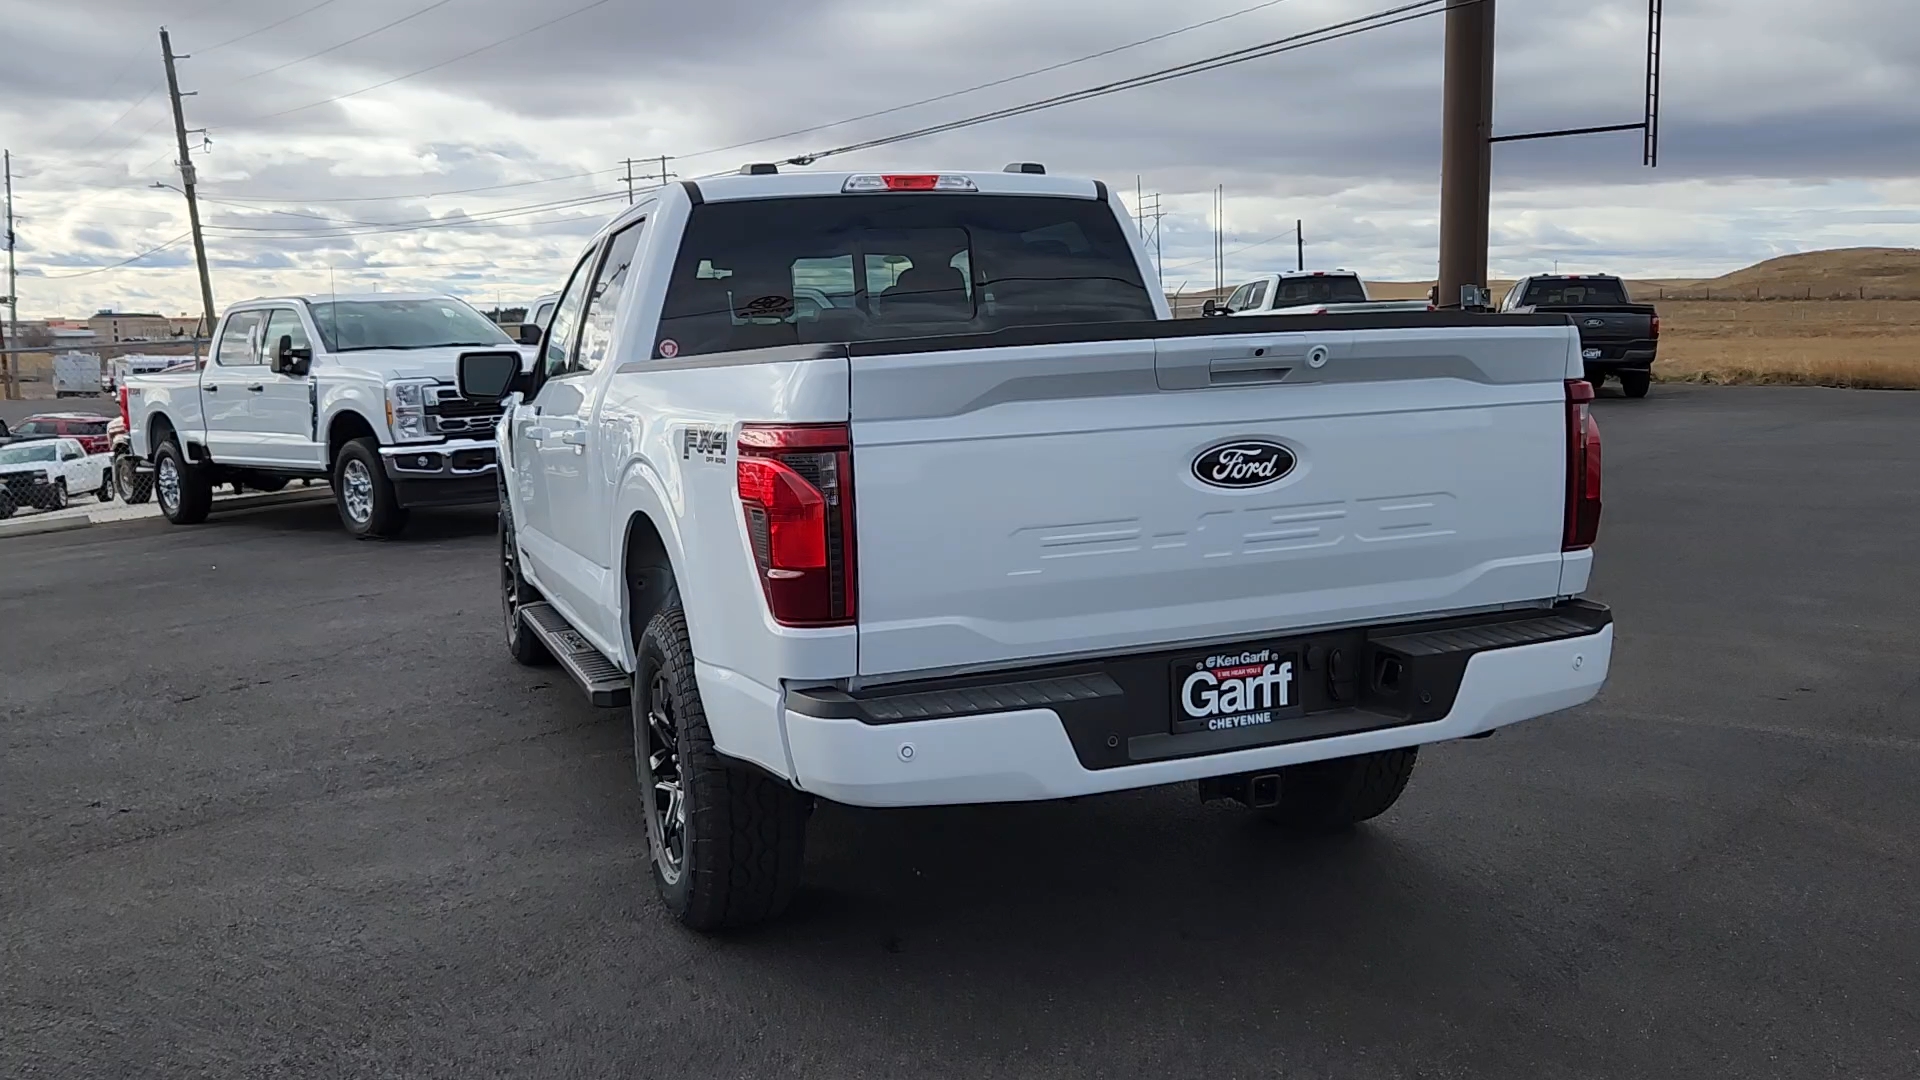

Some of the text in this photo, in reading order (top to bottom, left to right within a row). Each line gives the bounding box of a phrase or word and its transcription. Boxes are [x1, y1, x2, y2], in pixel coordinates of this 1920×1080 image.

[683, 428, 728, 460] FX4
[1212, 448, 1279, 480] Ford
[1216, 649, 1270, 667] Ken Garff
[1182, 661, 1292, 718] Garff
[1208, 711, 1272, 730] CHEYENNE
